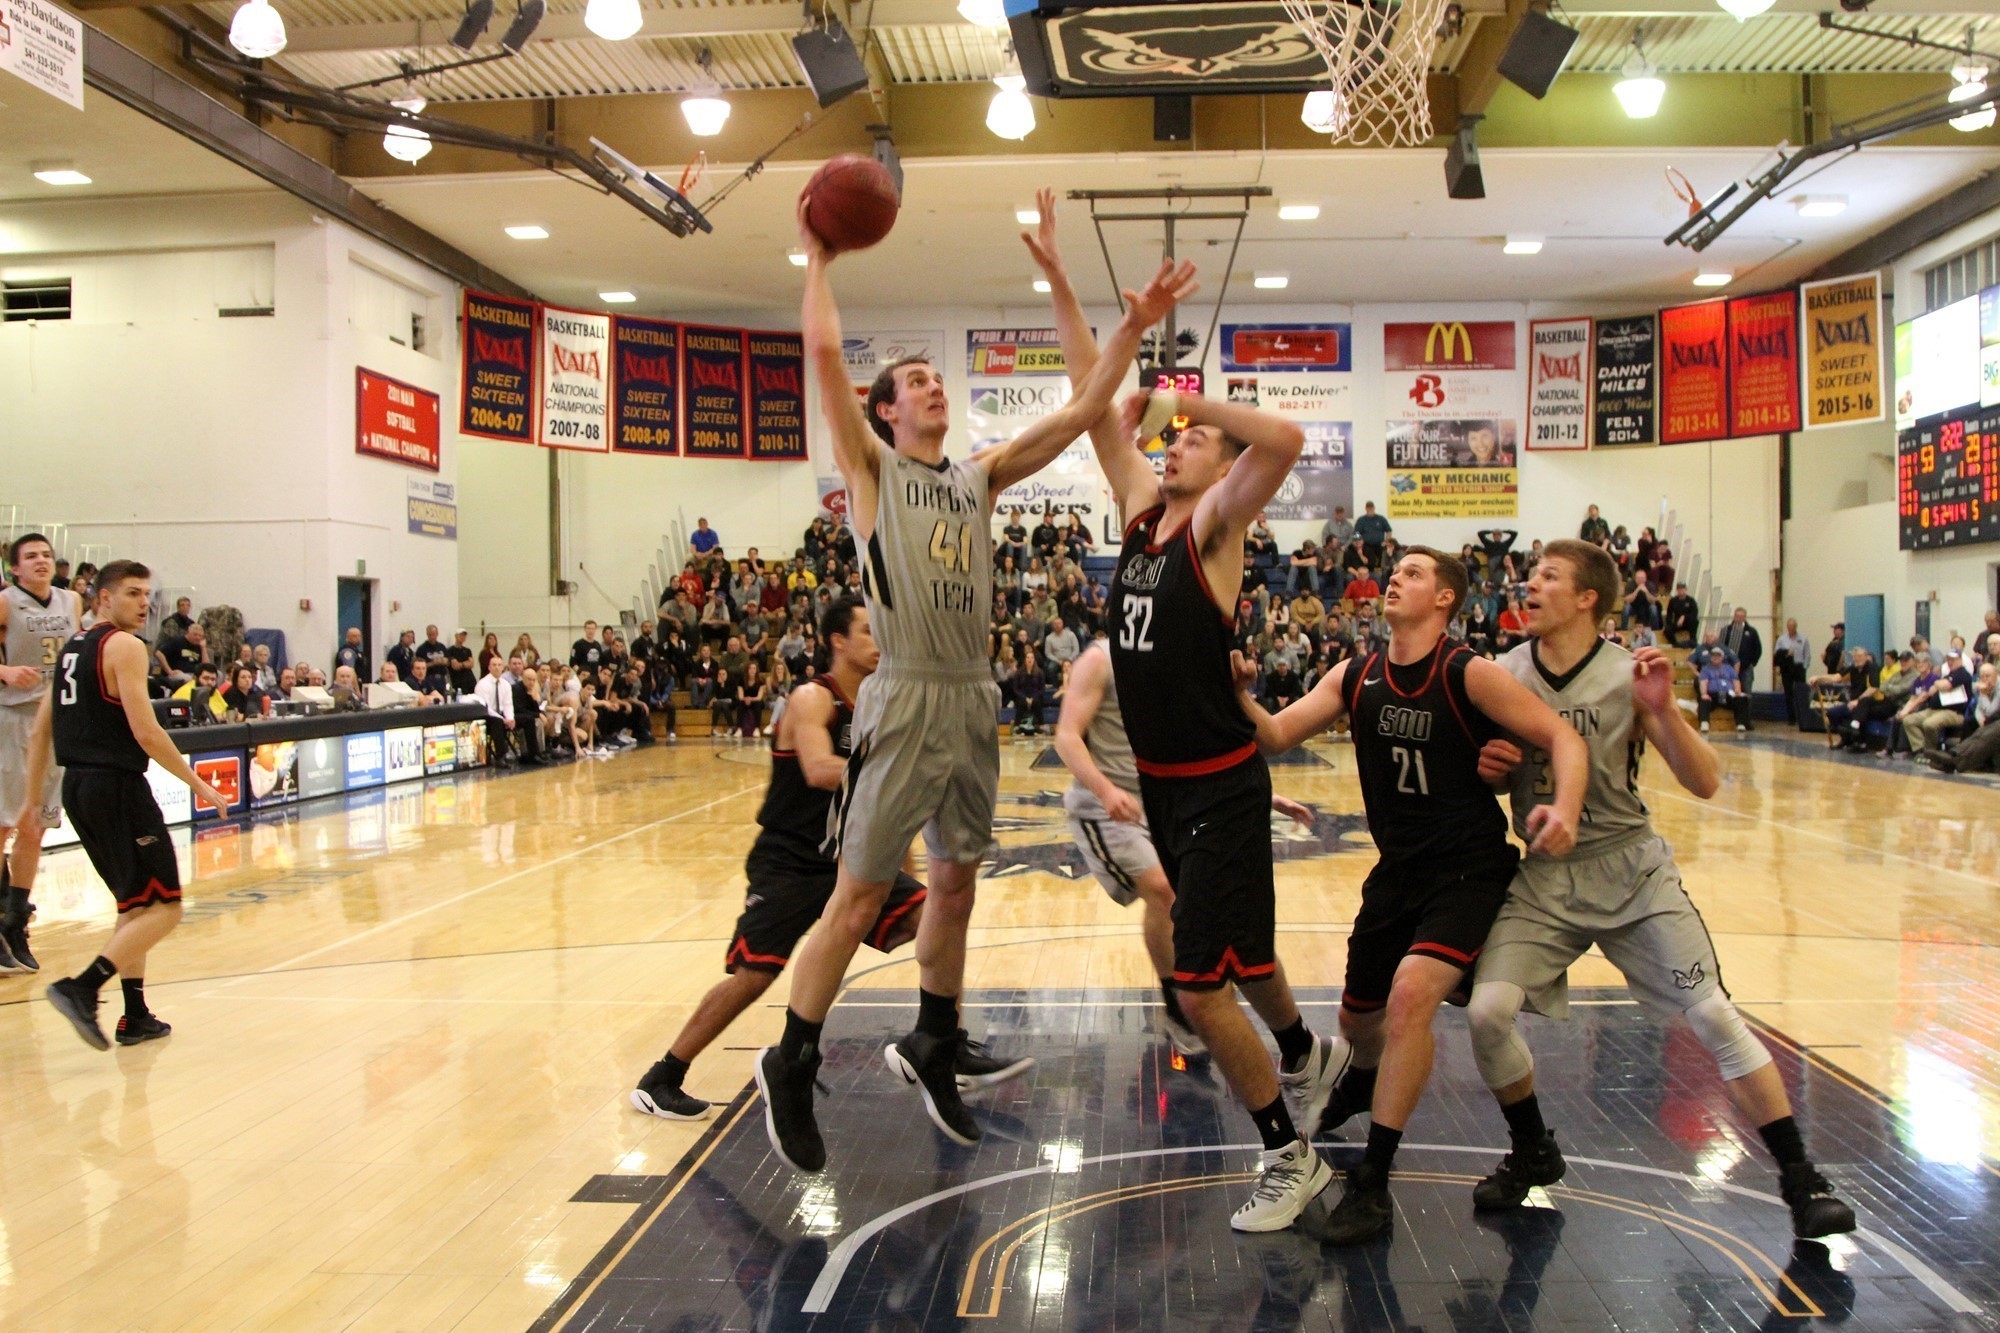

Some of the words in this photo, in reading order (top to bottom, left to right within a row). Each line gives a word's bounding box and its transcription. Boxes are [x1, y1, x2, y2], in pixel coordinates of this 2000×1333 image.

[1809, 286, 1874, 310] BASKETBALL
[469, 302, 531, 328] BASKETBALL
[1731, 301, 1792, 324] BASKETBALL
[547, 317, 605, 339] BASKETBALL
[618, 326, 675, 347] BASKETBALL
[972, 331, 1002, 342] PRIDE
[1004, 331, 1016, 342] IN
[1535, 329, 1586, 344] BASKETBALL
[1815, 312, 1872, 354] NAIA
[473, 328, 527, 373] NAIA
[686, 334, 741, 353] BASKETBALL
[750, 341, 802, 357] BASKETBALL
[552, 340, 603, 382] NAIA
[987, 349, 1015, 368] Tires
[1018, 353, 1036, 366] LES
[1538, 350, 1582, 385] NAIA
[1820, 353, 1868, 372] SWEET
[623, 350, 672, 387] NAIA
[692, 356, 738, 392] NAIA
[1598, 363, 1652, 379] DANNY
[476, 370, 521, 389] SWEET
[756, 362, 799, 396] NAIA
[1157, 374, 1200, 394] 2:22
[1600, 378, 1646, 393] MILES
[1816, 371, 1872, 390] SIXTEEN
[471, 385, 525, 406] SIXTEEN
[550, 382, 599, 400] NATIONAL
[626, 389, 667, 405] SWEET
[1537, 389, 1580, 401] NATIONAL
[544, 397, 606, 416] CHAMPIONS
[695, 395, 734, 410] SWEET
[759, 400, 797, 413] SWEET
[1000, 407, 1046, 416] CREDIT
[1279, 400, 1328, 410] 882-217
[1532, 404, 1584, 416] CHAMPIONS
[1817, 392, 1873, 416] 2015-16
[386, 410, 416, 433] SOFTBALL
[470, 406, 524, 432] 2006-07
[622, 405, 671, 421] SIXTEEN
[692, 410, 738, 425] SIXTEEN
[758, 415, 799, 428] SIXTEEN
[1606, 416, 1635, 428] FEB.
[1637, 416, 1643, 426] 1
[1738, 405, 1791, 428] 2014-15
[549, 418, 600, 440] 2007-08
[1536, 424, 1578, 440] 2011-12
[1669, 413, 1719, 434] 2013-14
[622, 425, 671, 446] 2008-09
[692, 430, 738, 449] 2009-10
[758, 434, 800, 450] 2010-11
[1608, 430, 1640, 442] 2014
[1941, 421, 1963, 453] 2:22
[370, 432, 400, 454] NATIONAL
[401, 440, 431, 462] CHAMPION
[1393, 443, 1447, 460] FUTURE
[1421, 474, 1440, 484] MY
[1446, 473, 1511, 484] MECHANIC
[996, 499, 1092, 515] ewelers
[928, 519, 972, 575] 41
[929, 578, 974, 614] TECH
[1119, 593, 1154, 652] 32
[60, 652, 80, 706] 3
[1378, 704, 1433, 741] SOU
[1391, 746, 1430, 795] 21
